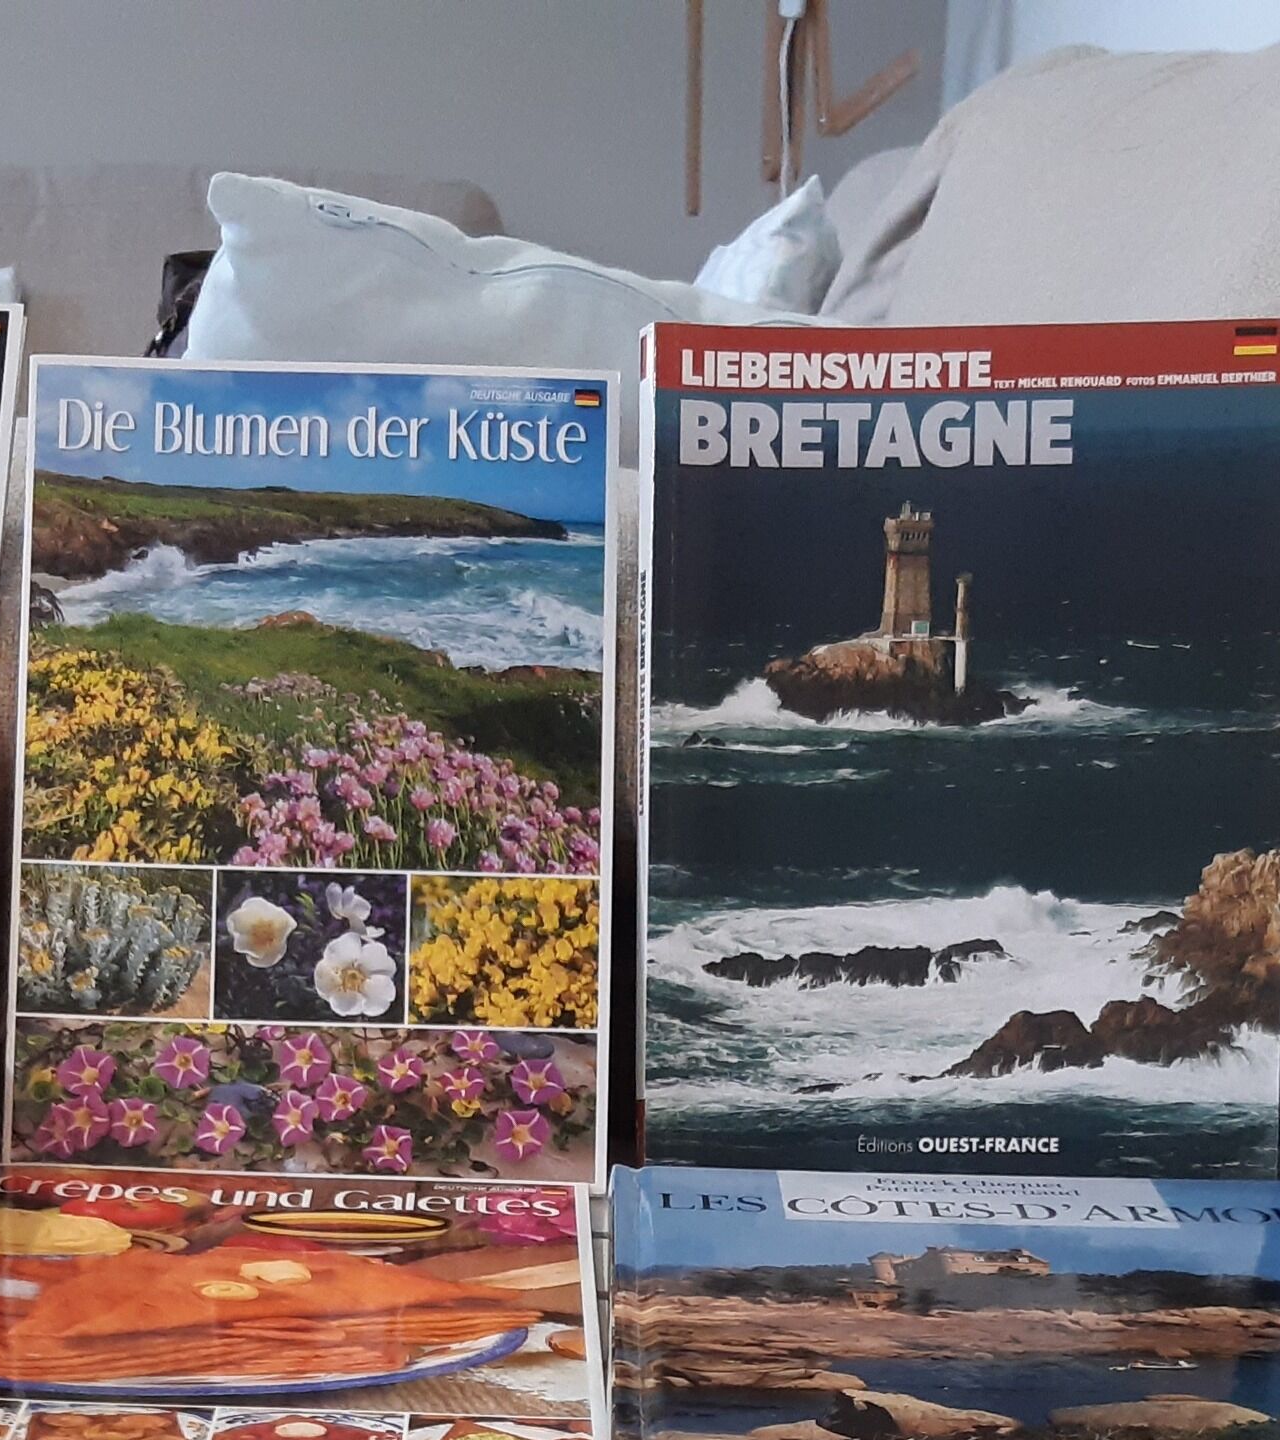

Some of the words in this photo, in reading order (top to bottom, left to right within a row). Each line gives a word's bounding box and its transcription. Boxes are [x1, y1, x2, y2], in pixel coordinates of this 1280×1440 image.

[680, 348, 993, 389] LIEBENSWERTE
[993, 379, 1016, 389] TEXT
[1017, 376, 1058, 389] MICHEL
[1060, 375, 1122, 388] RENOUARD
[1126, 376, 1156, 387] FOTOS
[1157, 372, 1220, 386] EMMANUEL
[1220, 371, 1277, 384] BERTHIER
[57, 397, 136, 452] Die
[155, 401, 328, 458] Blumen
[347, 406, 428, 459] der
[448, 408, 588, 464] Küste
[679, 398, 1075, 469] BRETAGNE
[856, 1133, 913, 1154] Éditions
[918, 1135, 1060, 1154] OUEST-FRANCE
[210, 1185, 314, 1212] und
[333, 1188, 561, 1219] Galettes
[660, 1191, 767, 1214] LES
